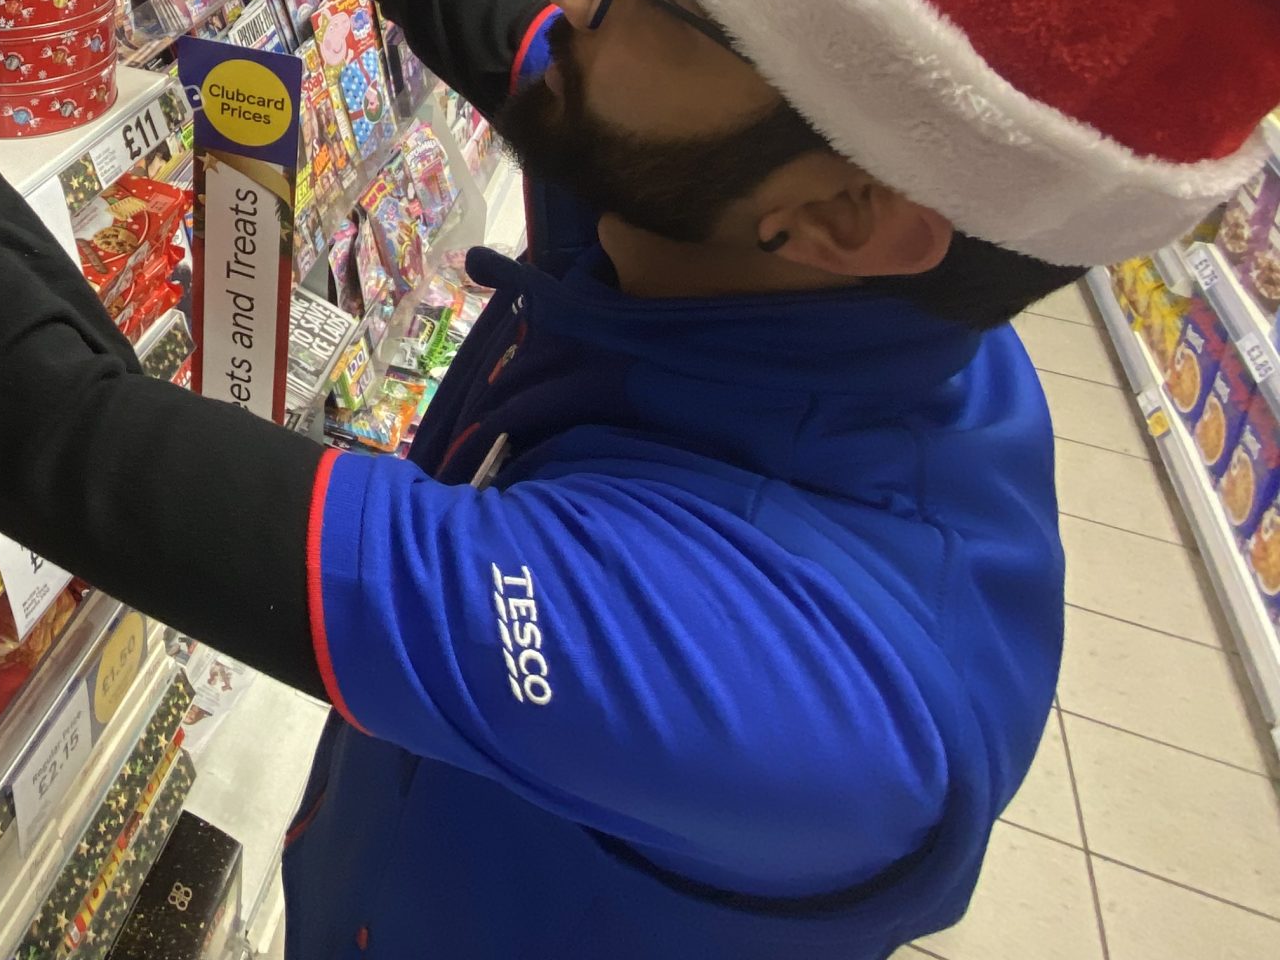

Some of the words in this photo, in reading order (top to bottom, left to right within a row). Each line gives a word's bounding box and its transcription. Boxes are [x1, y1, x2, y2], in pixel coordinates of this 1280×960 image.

[236, 7, 267, 46] PRIVATE
[208, 83, 285, 111] Clubcard
[220, 102, 272, 125] Prices
[122, 107, 159, 160] £11
[226, 188, 258, 279] Treats
[1195, 259, 1218, 287] £1.75
[226, 289, 255, 349] and
[299, 301, 332, 333] SAVE
[319, 313, 350, 342] LADS
[291, 328, 314, 349] TO
[309, 333, 335, 361] ICE
[503, 565, 552, 705] TESCO
[102, 634, 136, 694] £1.50
[32, 737, 60, 785] Regular
[38, 728, 79, 799] £2.15
